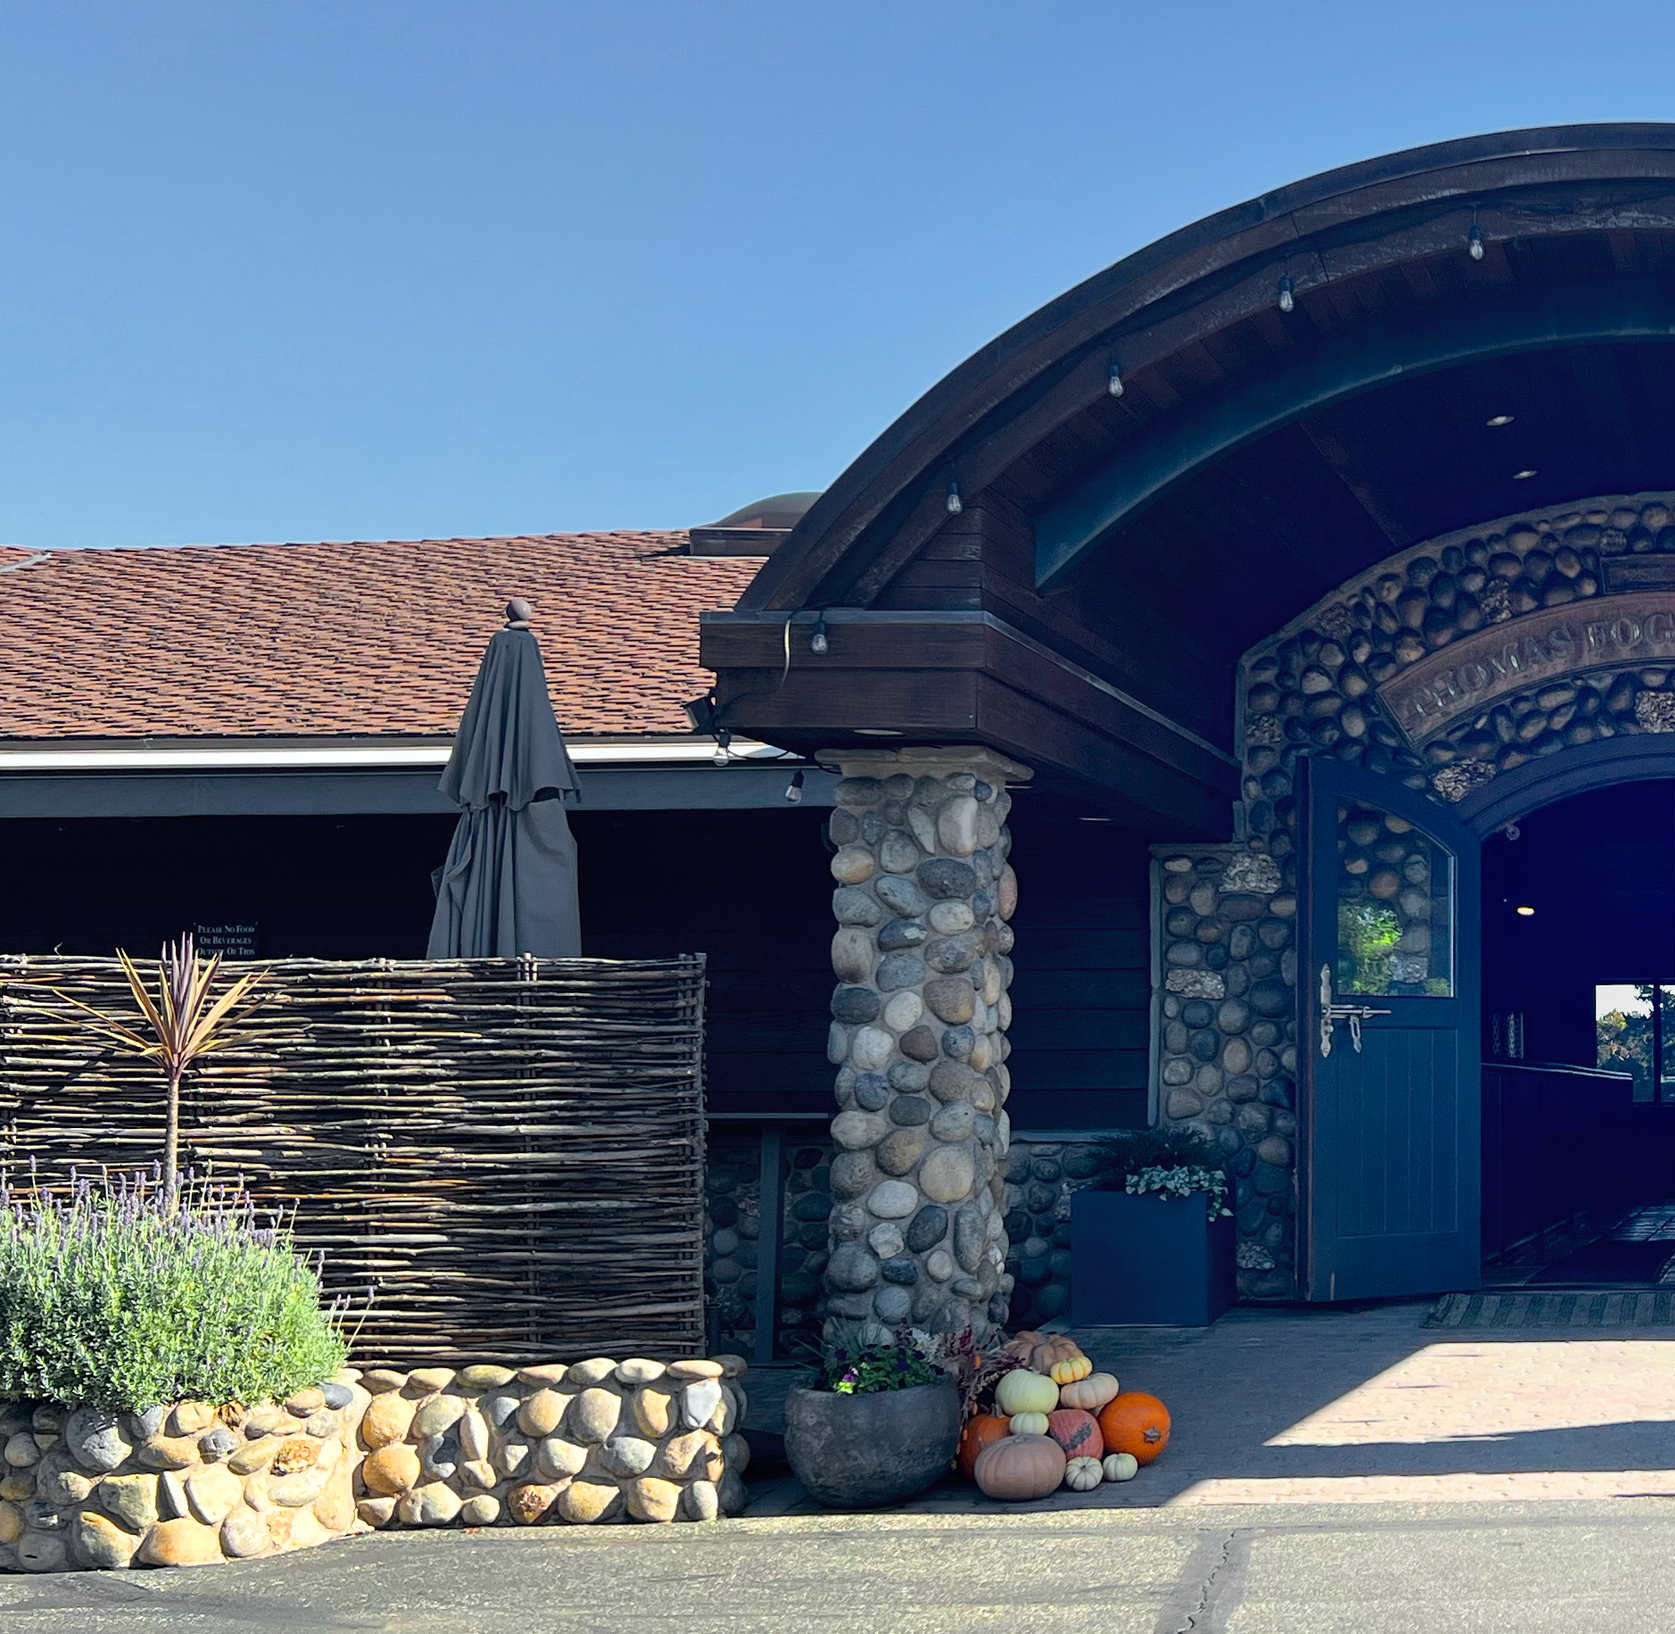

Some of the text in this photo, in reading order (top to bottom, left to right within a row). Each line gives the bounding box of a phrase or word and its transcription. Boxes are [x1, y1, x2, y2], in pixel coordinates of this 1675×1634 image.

[1405, 626, 1575, 720] THOMAS
[197, 924, 223, 934] PLEASE
[236, 924, 255, 934] FOOD
[212, 936, 252, 945] BEVERAGES
